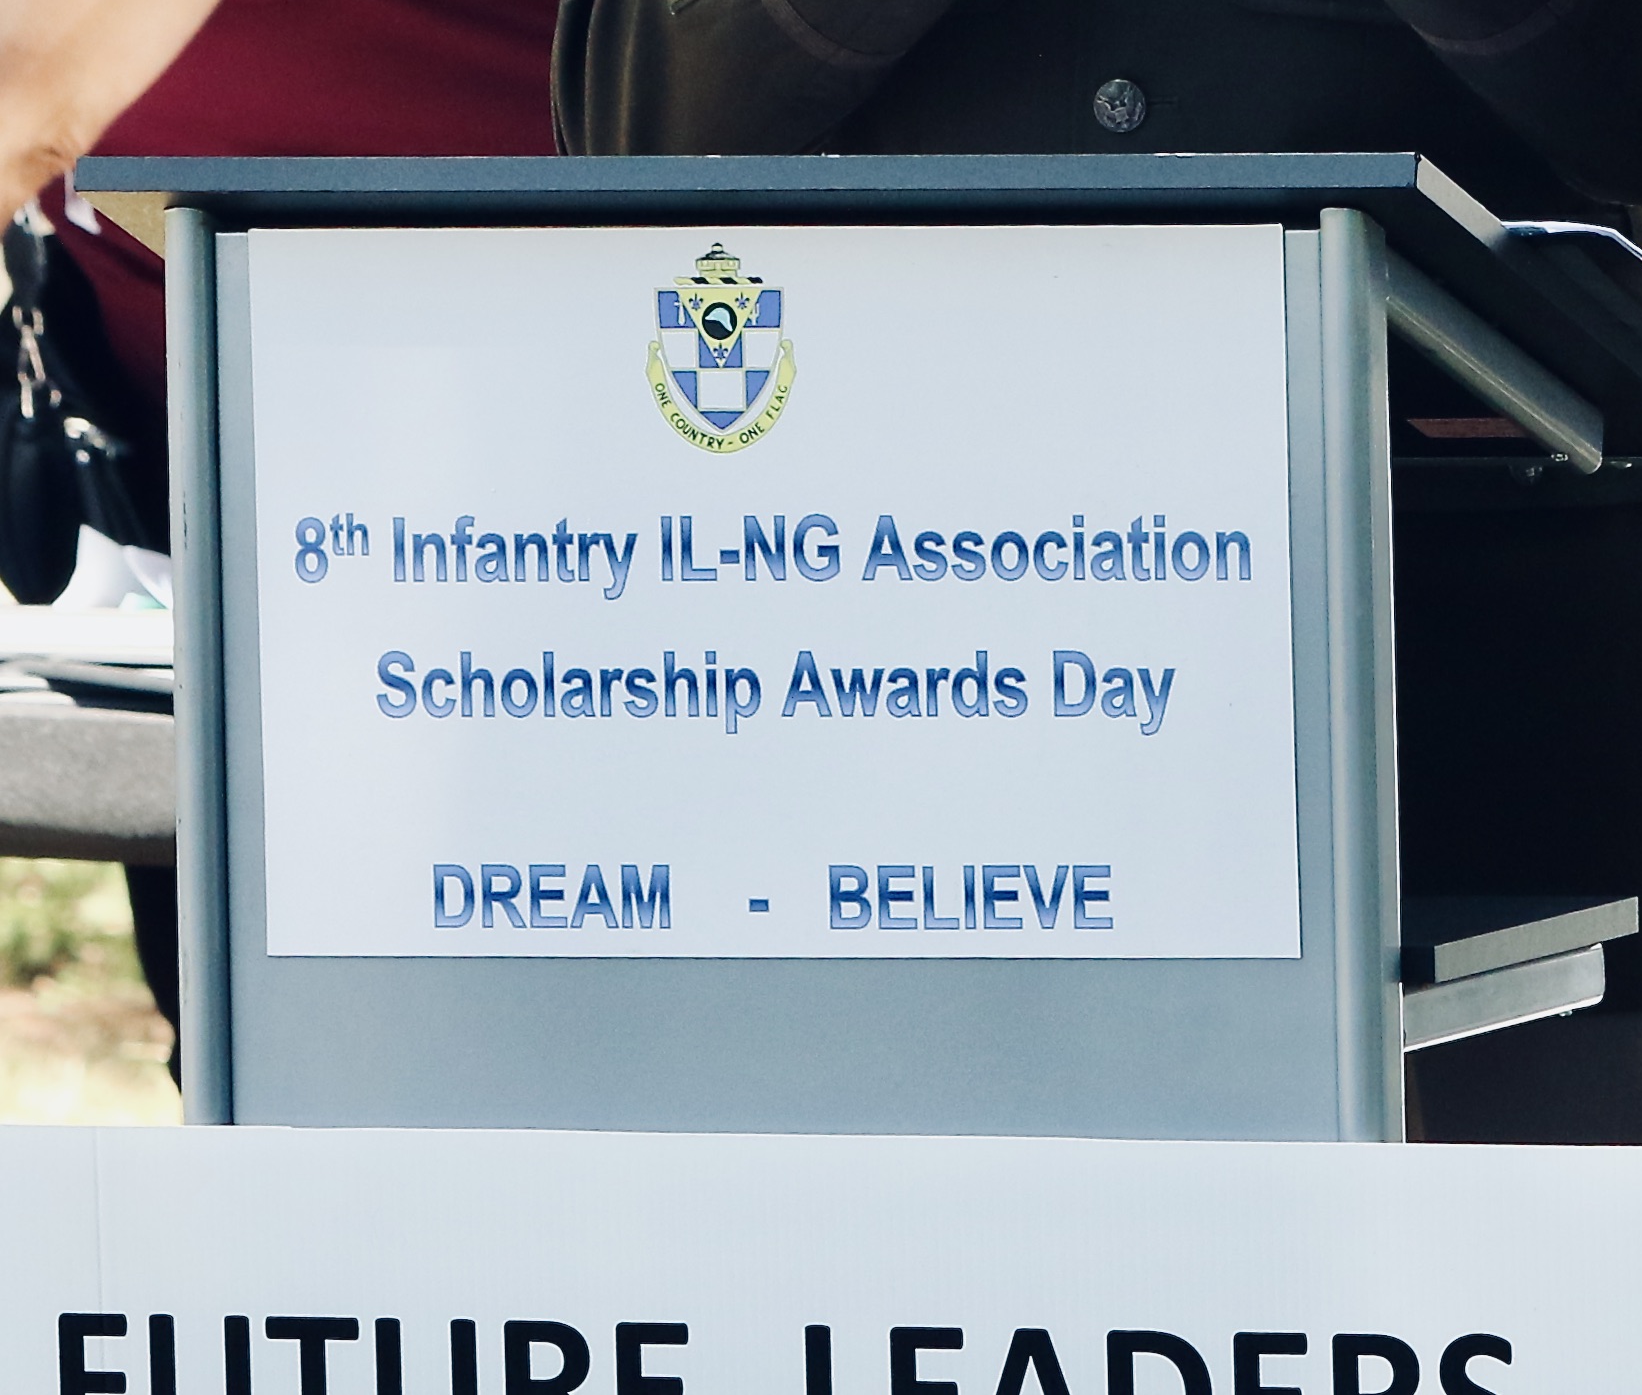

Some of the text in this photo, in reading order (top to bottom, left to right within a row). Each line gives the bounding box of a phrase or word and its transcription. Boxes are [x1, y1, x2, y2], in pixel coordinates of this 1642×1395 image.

[655, 382, 672, 409] ONE
[670, 412, 725, 450] COUNTRY
[739, 424, 765, 444] ONE
[765, 385, 788, 420] FLAG
[294, 513, 1253, 601] 8th Infantry IL-NG Association
[376, 650, 1177, 737] Scholarship Awards Day
[432, 864, 673, 931] DREAM
[828, 865, 1115, 932] BELIEVE
